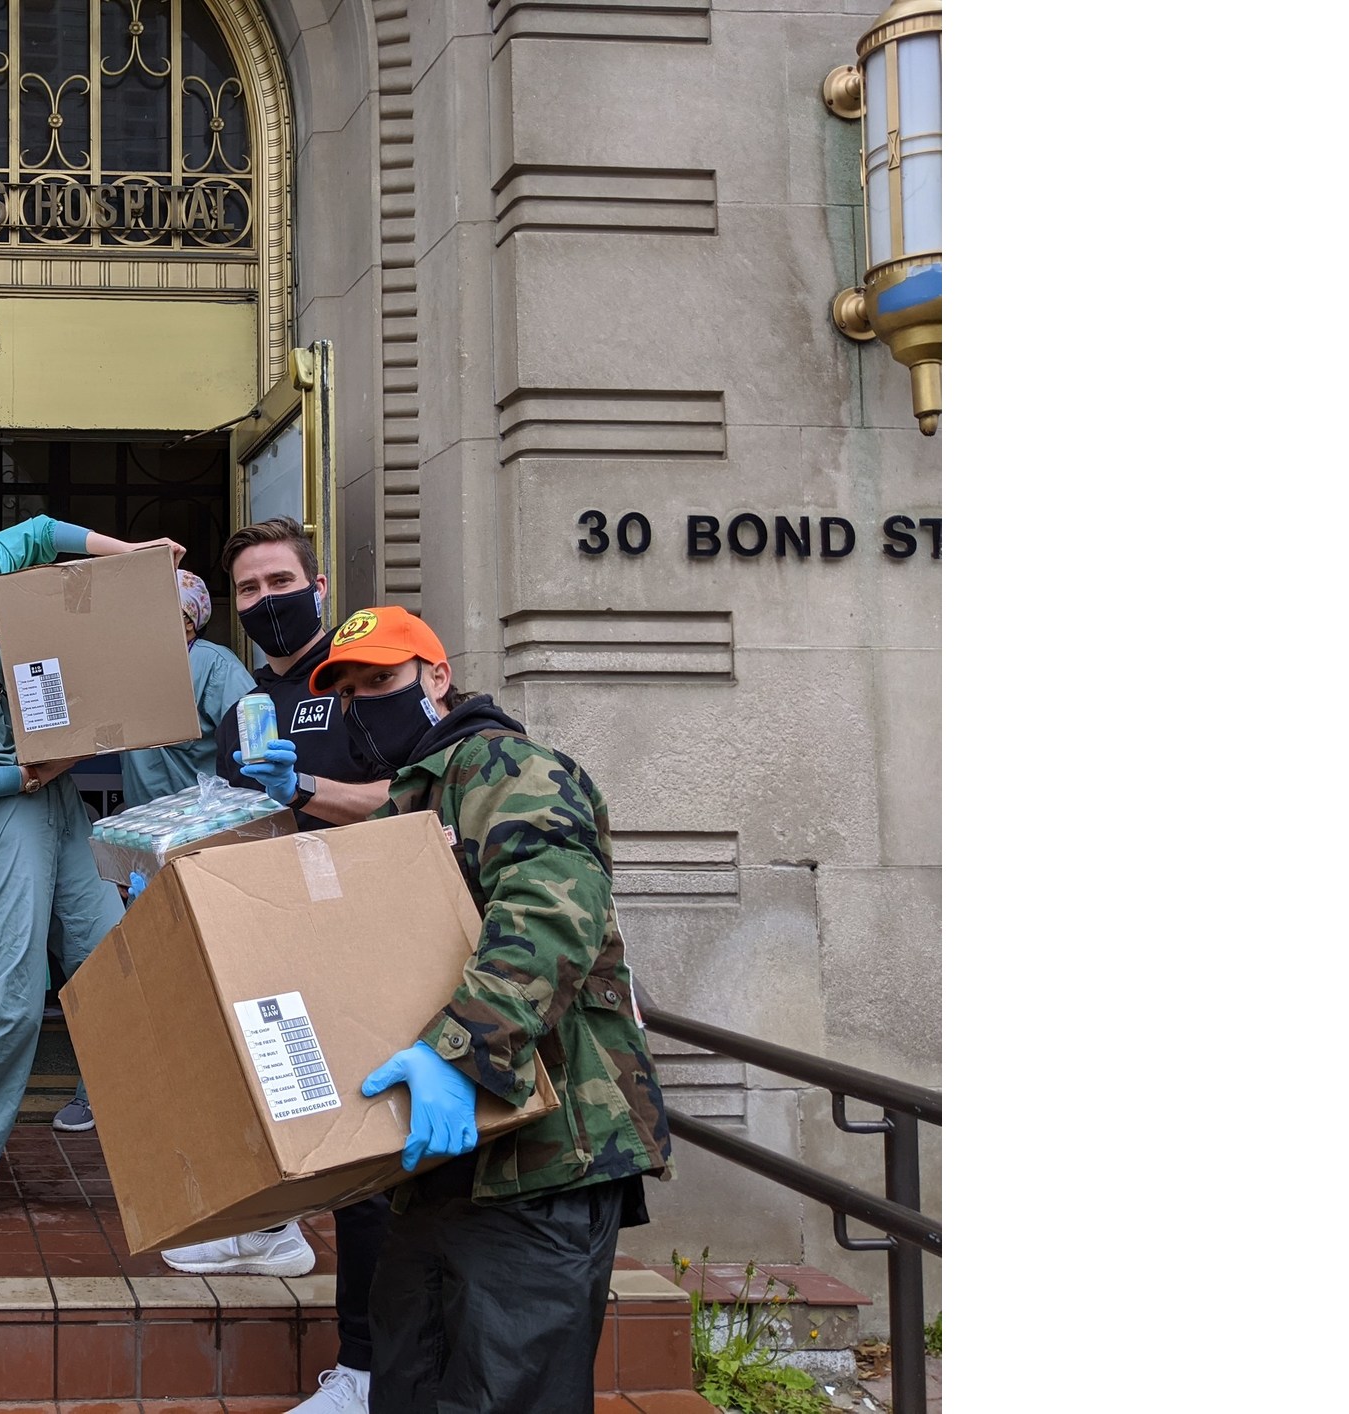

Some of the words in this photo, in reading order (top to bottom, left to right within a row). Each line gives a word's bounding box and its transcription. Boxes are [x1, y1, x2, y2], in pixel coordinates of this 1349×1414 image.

[34, 183, 236, 231] HOSPITAL
[578, 510, 652, 555] 30
[687, 512, 856, 559] BOND
[882, 514, 942, 560] ST
[300, 705, 324, 715] BIO
[298, 713, 324, 724] RAW
[112, 793, 117, 802] 5
[263, 1010, 278, 1018] RAW
[274, 1110, 290, 1118] KEEP
[291, 1099, 337, 1115] REFRIGERATED
